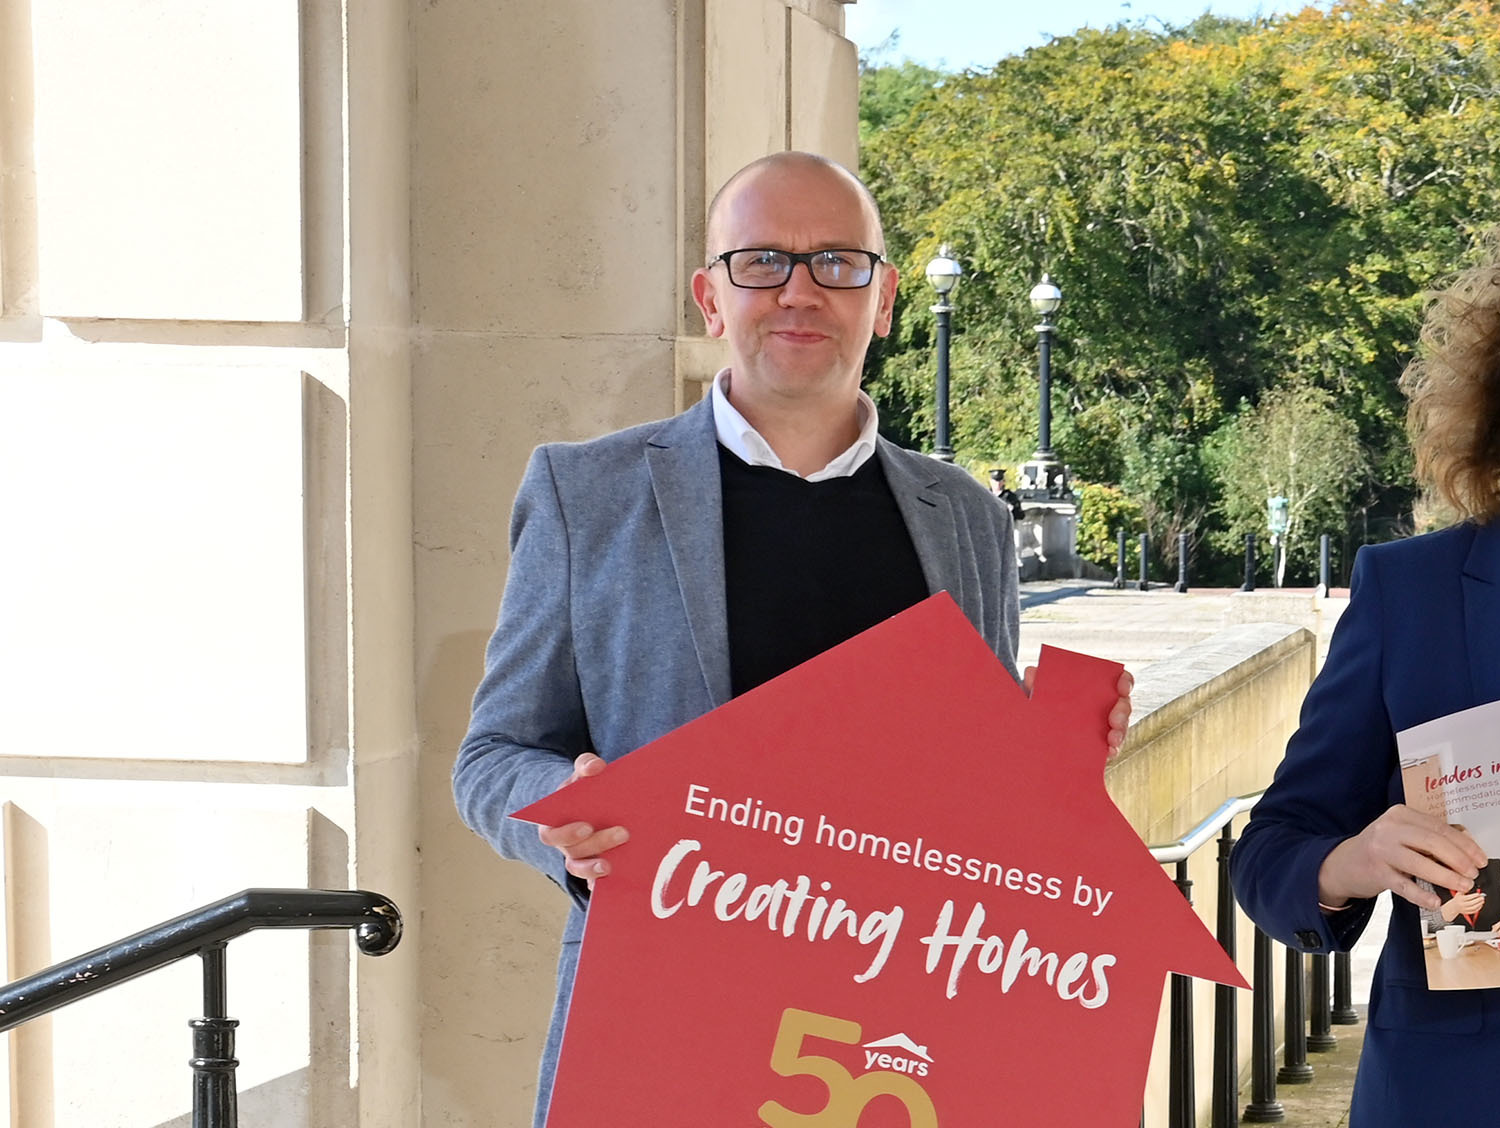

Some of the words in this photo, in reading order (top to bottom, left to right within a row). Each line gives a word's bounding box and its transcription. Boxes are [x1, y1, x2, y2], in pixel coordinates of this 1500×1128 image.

[684, 783, 805, 846] Ending
[815, 814, 1063, 900] homelessness
[1072, 875, 1114, 917] by
[650, 838, 905, 984] Creating
[919, 899, 1118, 1009] Homes
[864, 1049, 929, 1077] years
